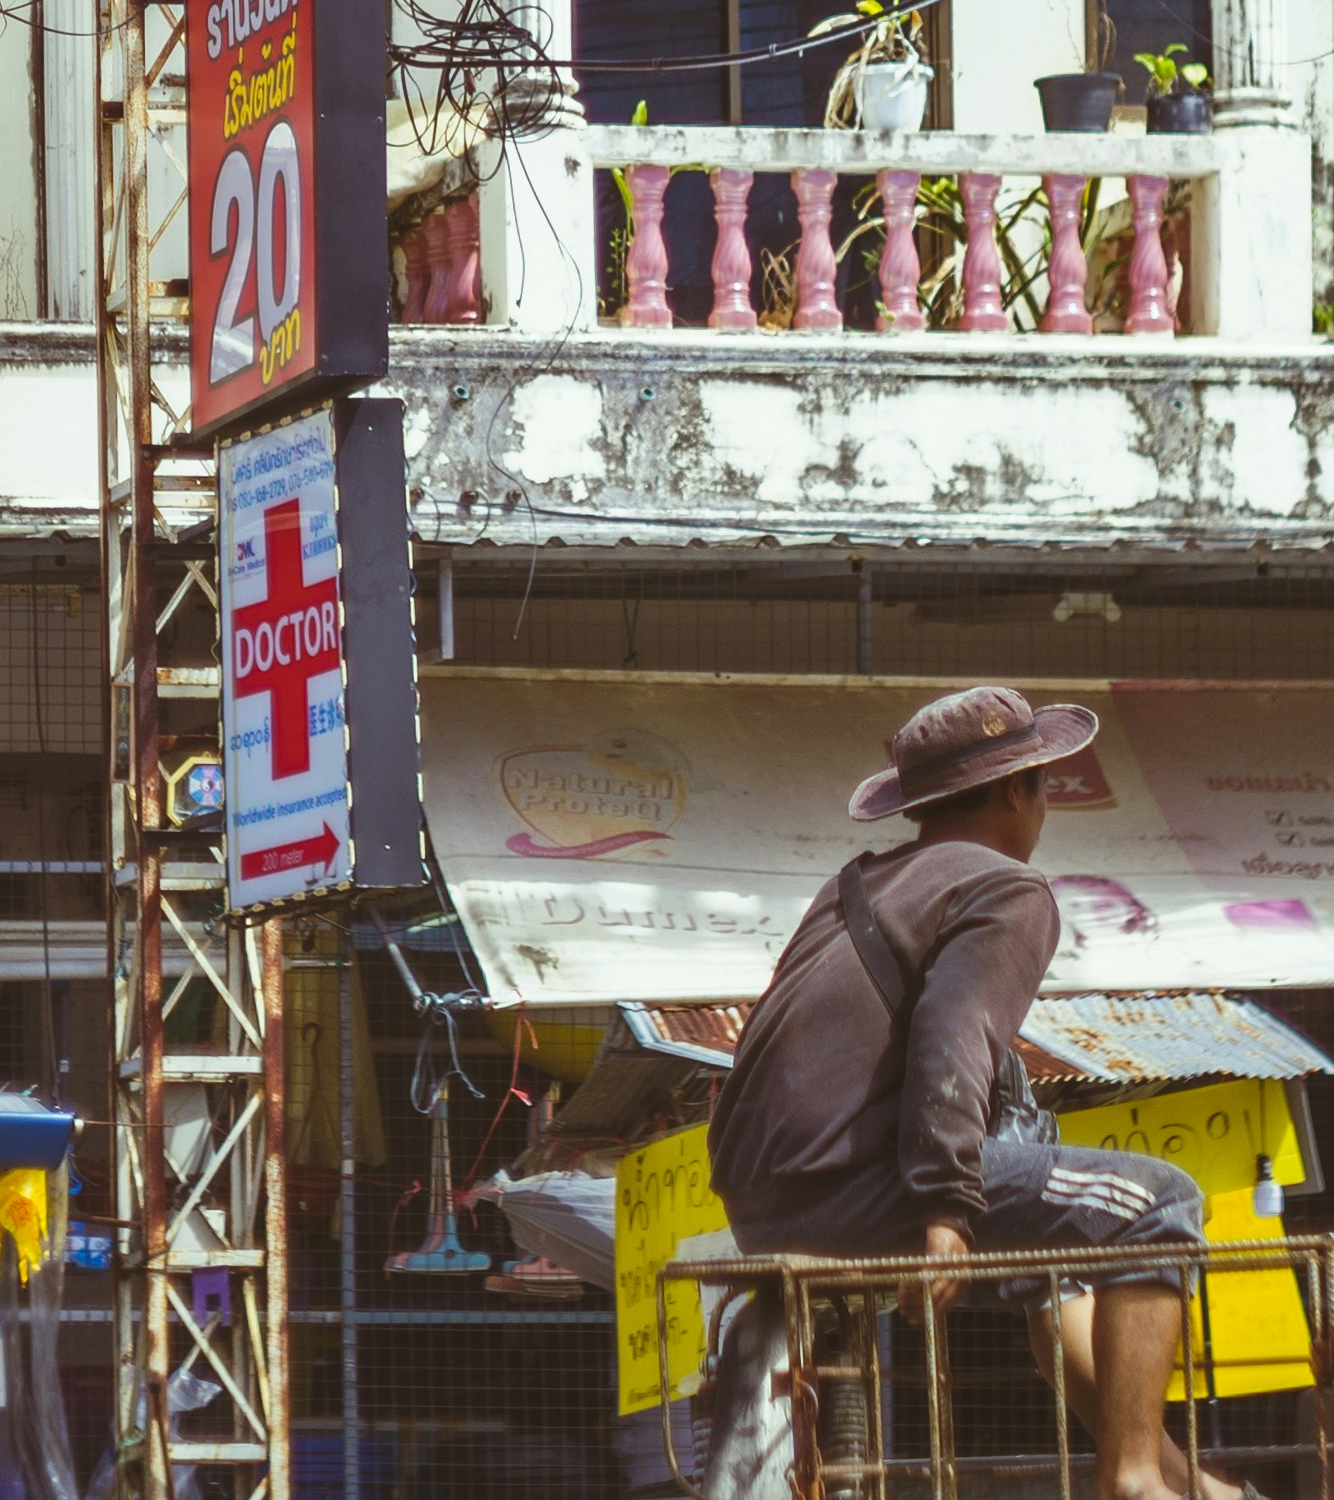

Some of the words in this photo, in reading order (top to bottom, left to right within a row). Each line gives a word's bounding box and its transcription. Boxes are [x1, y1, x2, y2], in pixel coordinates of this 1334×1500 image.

[223, 10, 297, 140] เริ่มต้นที่
[210, 121, 300, 387] 20
[259, 306, 301, 385] บาท
[235, 601, 335, 678] DOCTOR
[233, 803, 275, 828] Worldwide
[276, 795, 315, 817] insurance
[315, 783, 348, 808] accepted
[506, 766, 675, 801] Natural
